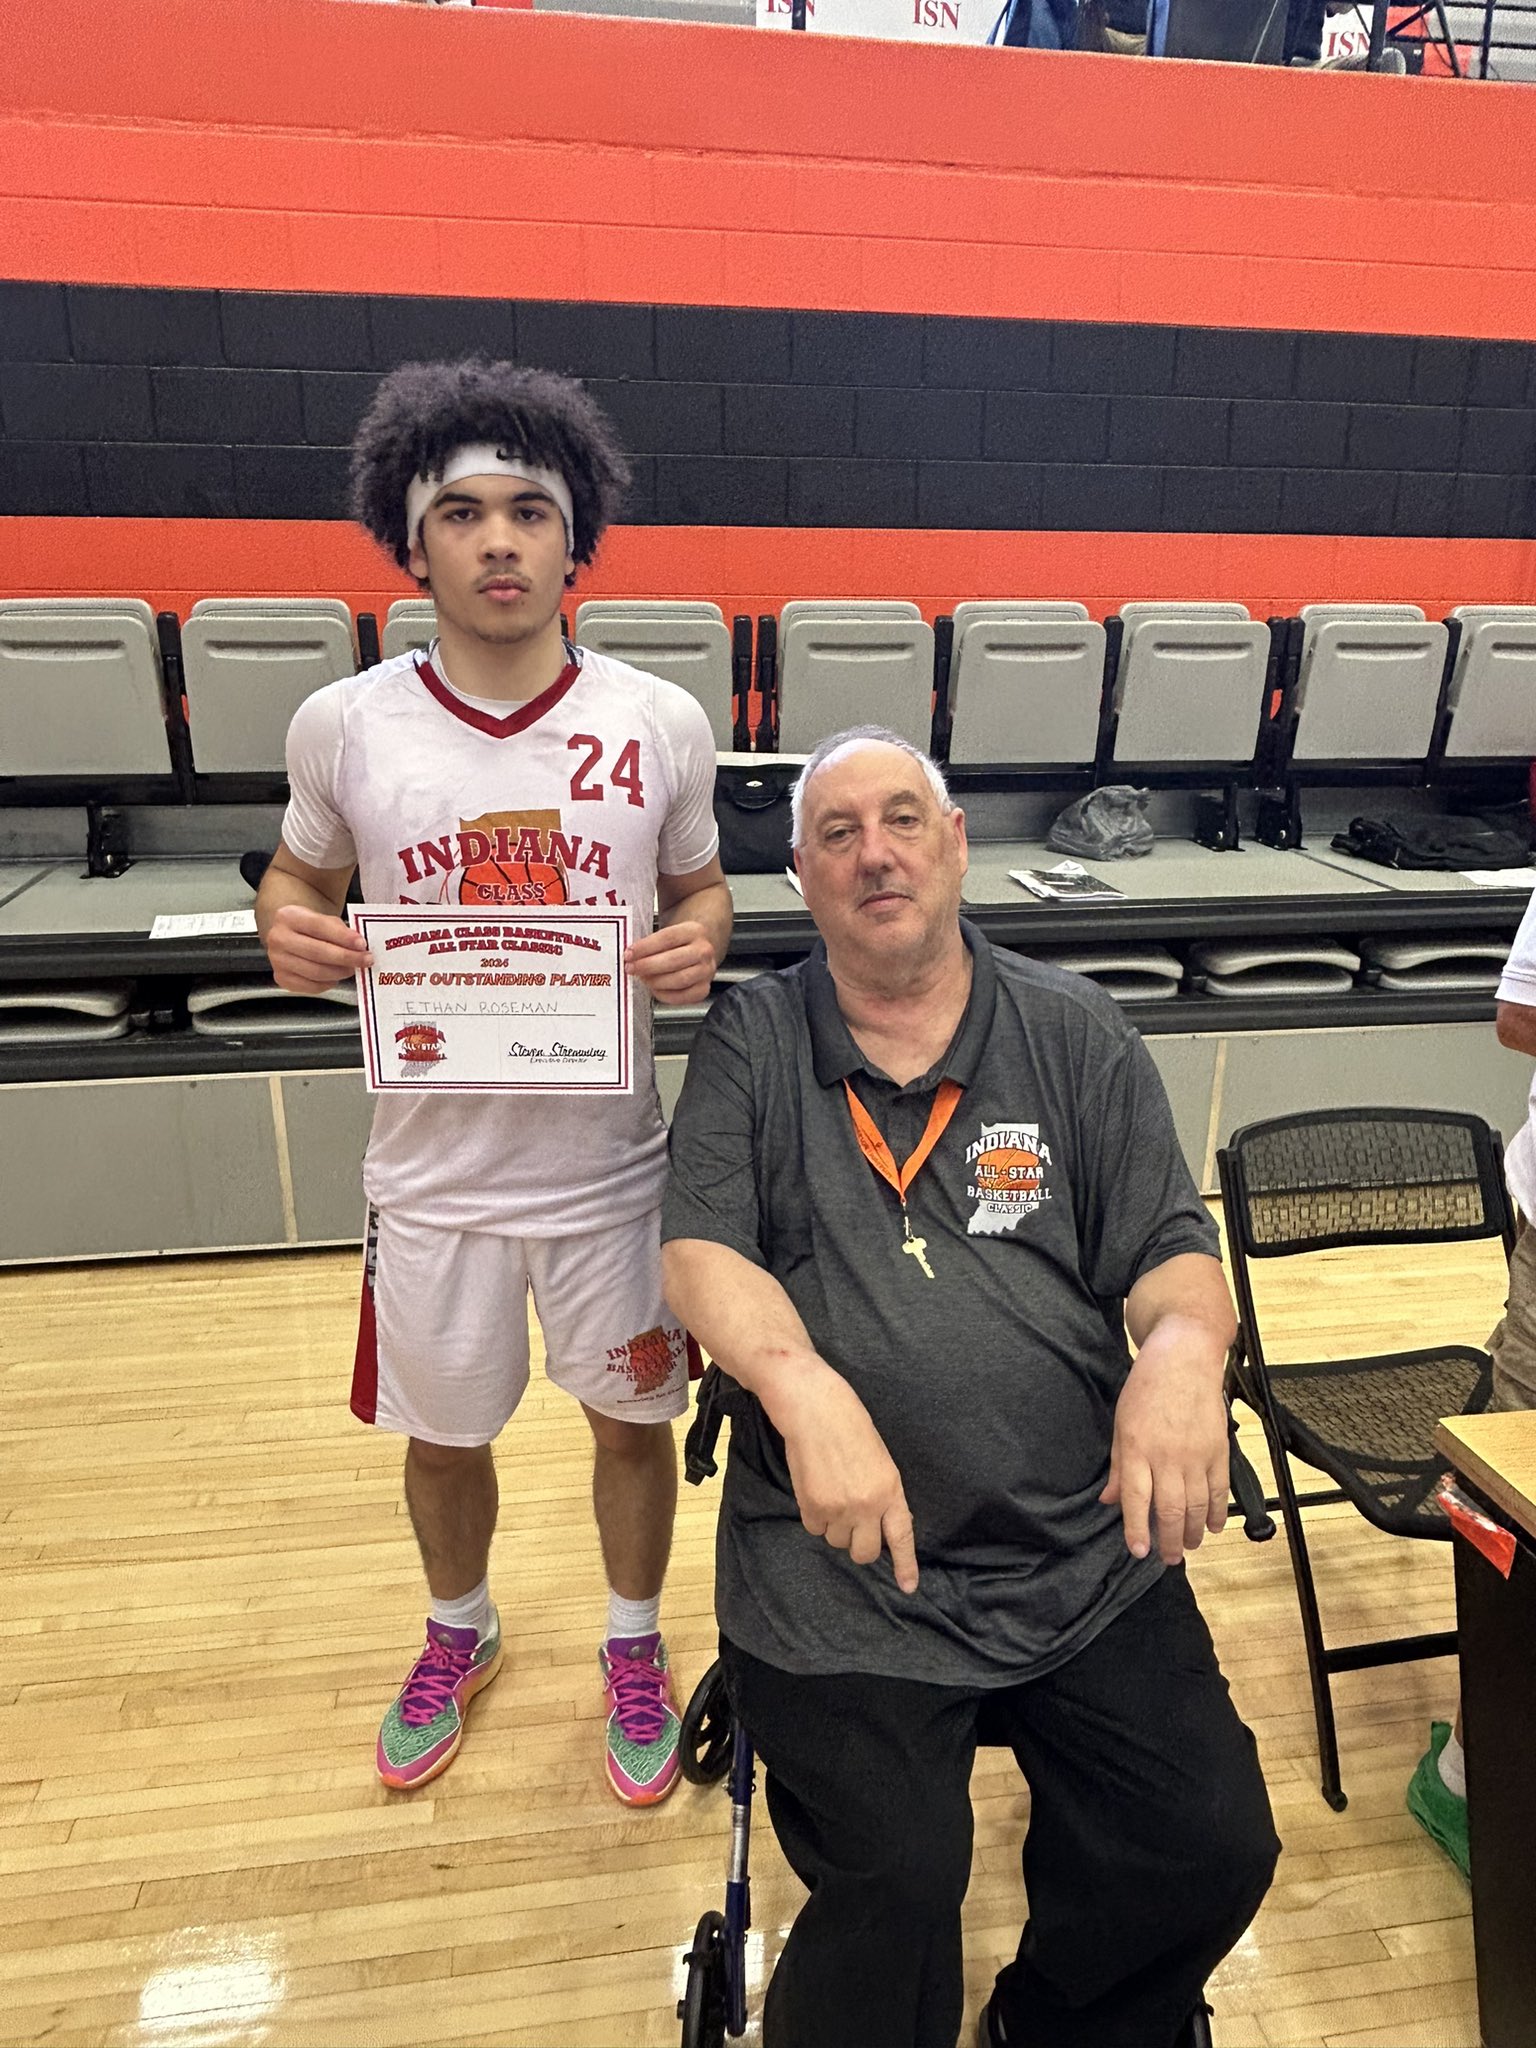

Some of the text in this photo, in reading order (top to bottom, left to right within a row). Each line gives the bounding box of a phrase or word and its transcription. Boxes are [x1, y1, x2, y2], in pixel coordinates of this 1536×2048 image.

[912, 0, 961, 30] ISN
[567, 733, 645, 808] 24
[397, 827, 612, 884] INDIANA
[477, 882, 545, 900] CLASS
[385, 926, 601, 951] INDIANA CLASS BASKETBALL
[428, 939, 563, 956] ALL STAR CLASSIC
[378, 972, 612, 987] MOST OUTSTANDING PLAYER
[406, 1001, 467, 1014] ETHAN
[965, 1131, 1052, 1166] INDIANA
[967, 1185, 1052, 1201] BASKETBALL
[987, 1203, 1033, 1214] CLASSIC
